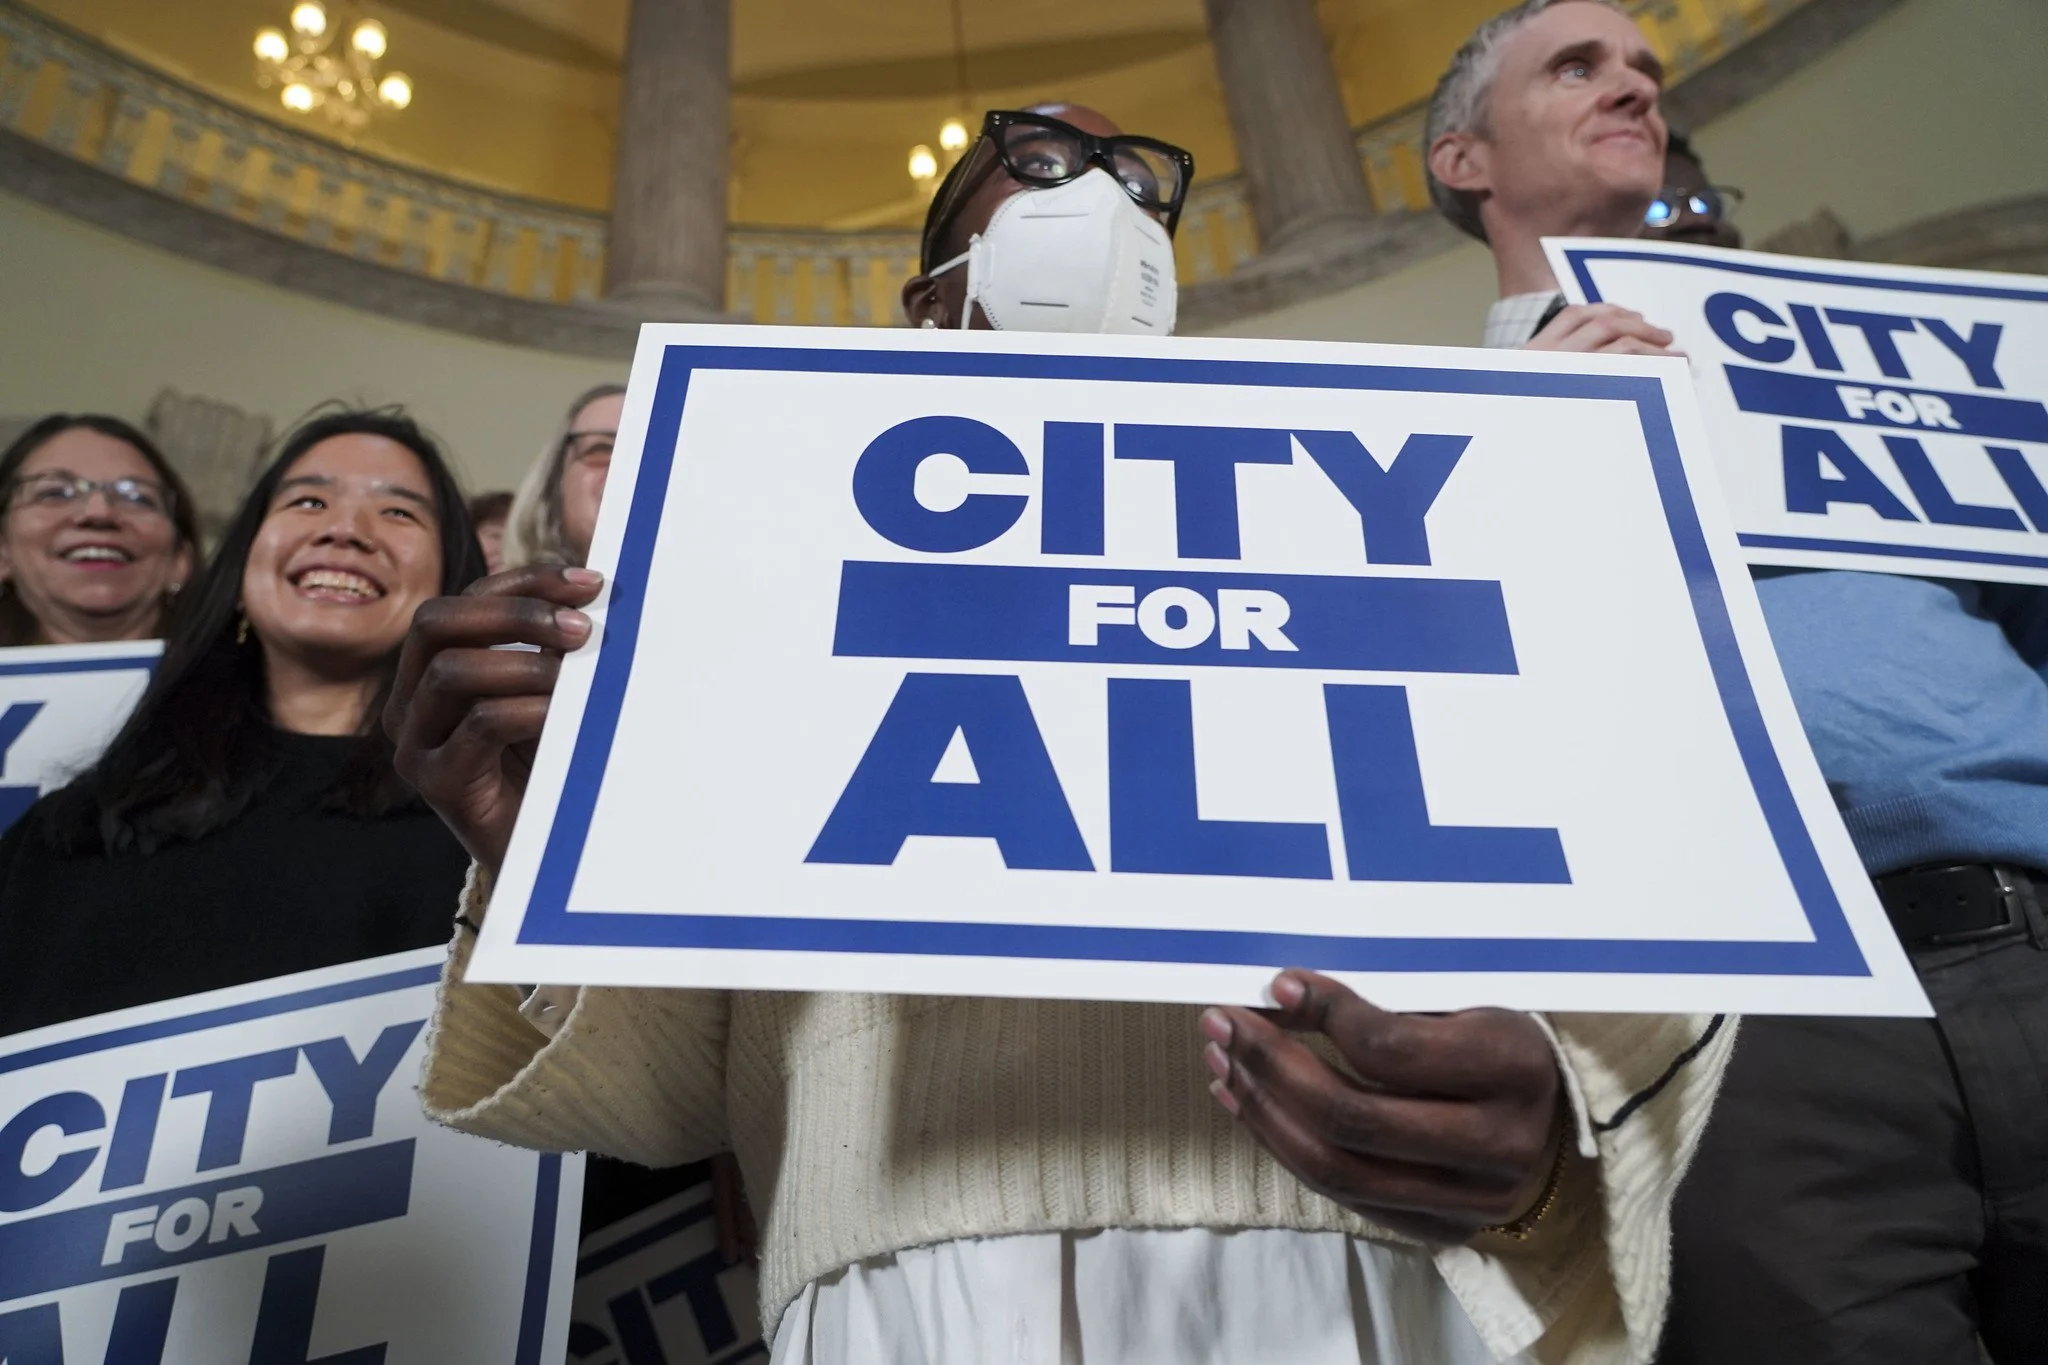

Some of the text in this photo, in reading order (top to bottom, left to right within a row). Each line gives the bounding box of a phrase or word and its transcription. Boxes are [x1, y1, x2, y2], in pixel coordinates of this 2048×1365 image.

[1704, 292, 2005, 390] CITY
[1836, 385, 1962, 430] FOR
[852, 415, 1474, 567] CITY
[1069, 584, 1300, 652] FOR
[803, 672, 1573, 884] ALL
[0, 1018, 428, 1212] CITY
[101, 1186, 264, 1267] FOR
